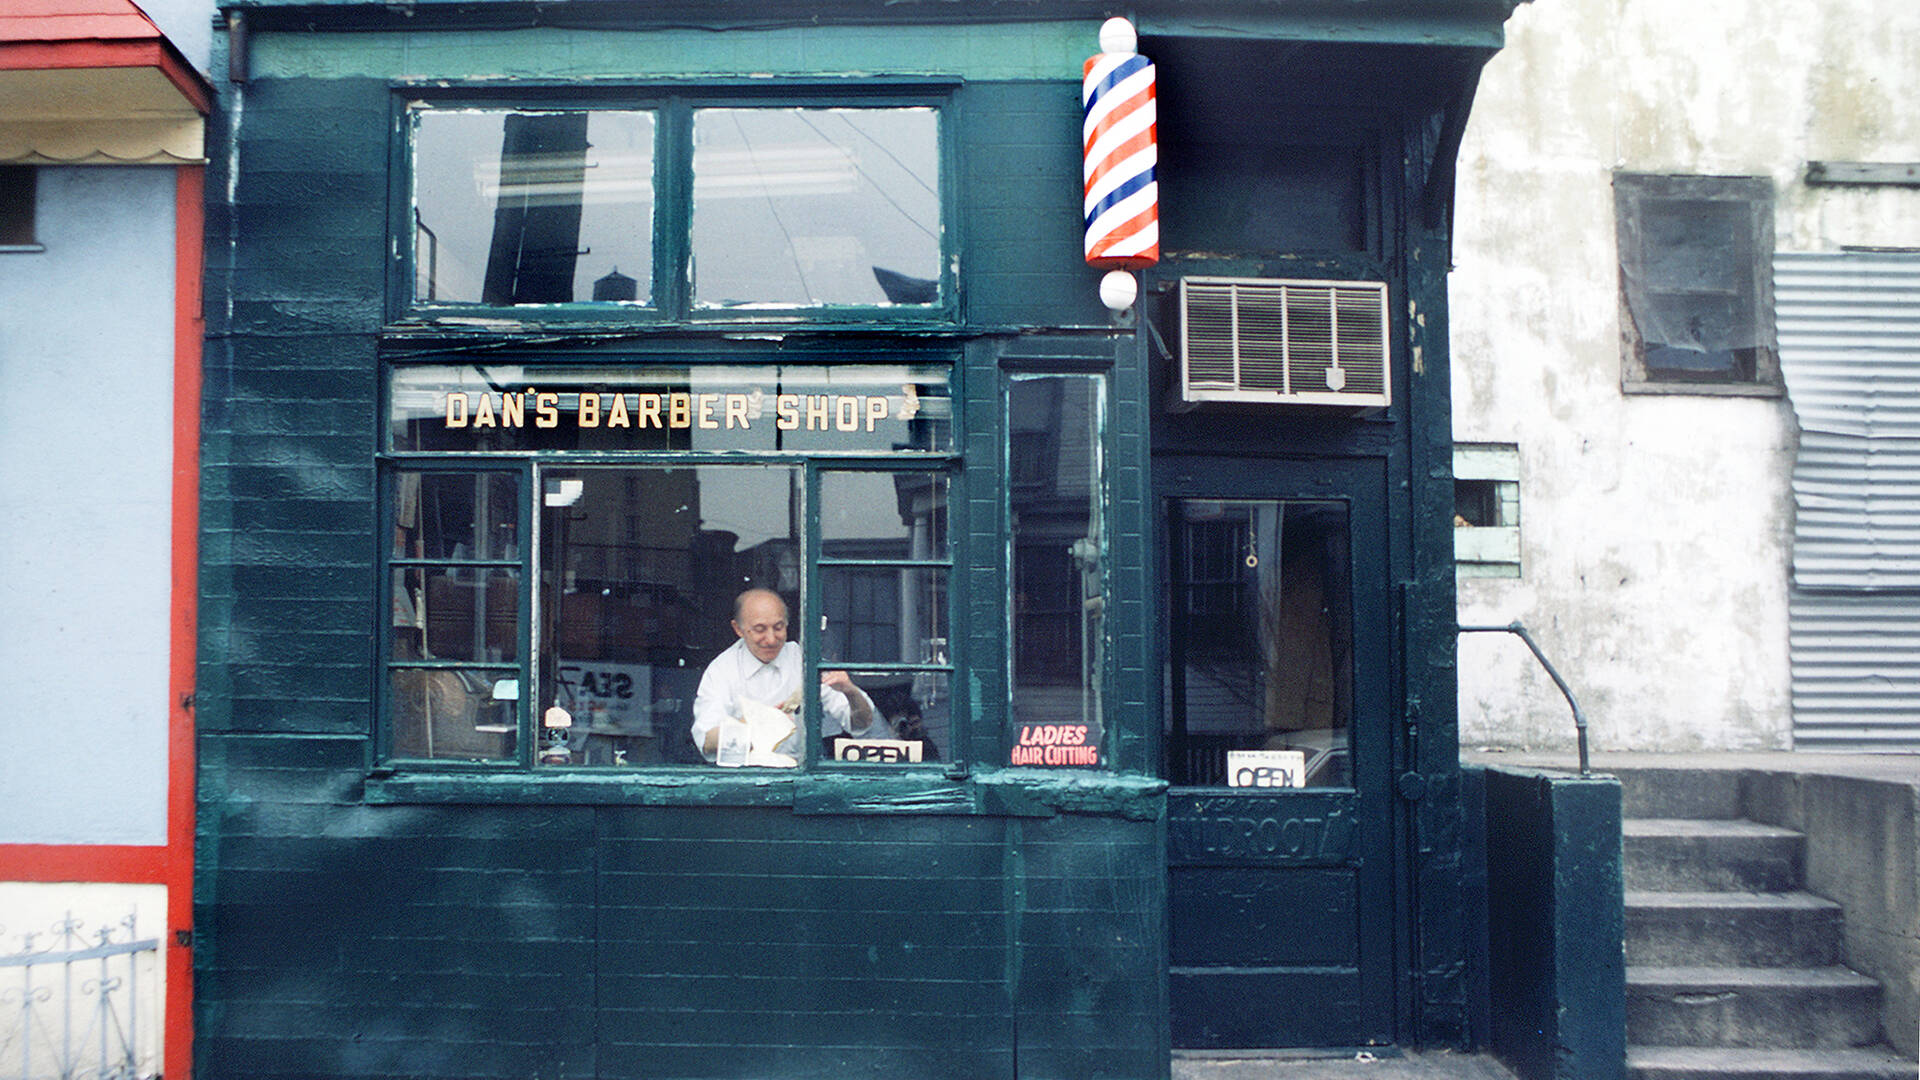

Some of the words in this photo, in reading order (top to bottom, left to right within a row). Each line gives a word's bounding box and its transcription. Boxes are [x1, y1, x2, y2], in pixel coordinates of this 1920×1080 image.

[444, 387, 560, 430] DAN'S
[577, 392, 751, 431] BARBER
[776, 392, 890, 433] SHOP
[1019, 725, 1088, 746] LADIES
[842, 744, 910, 763] OPEN
[1011, 744, 1044, 766] HAIR
[1044, 744, 1098, 767] CUTTING
[1237, 766, 1294, 788] OPEN
